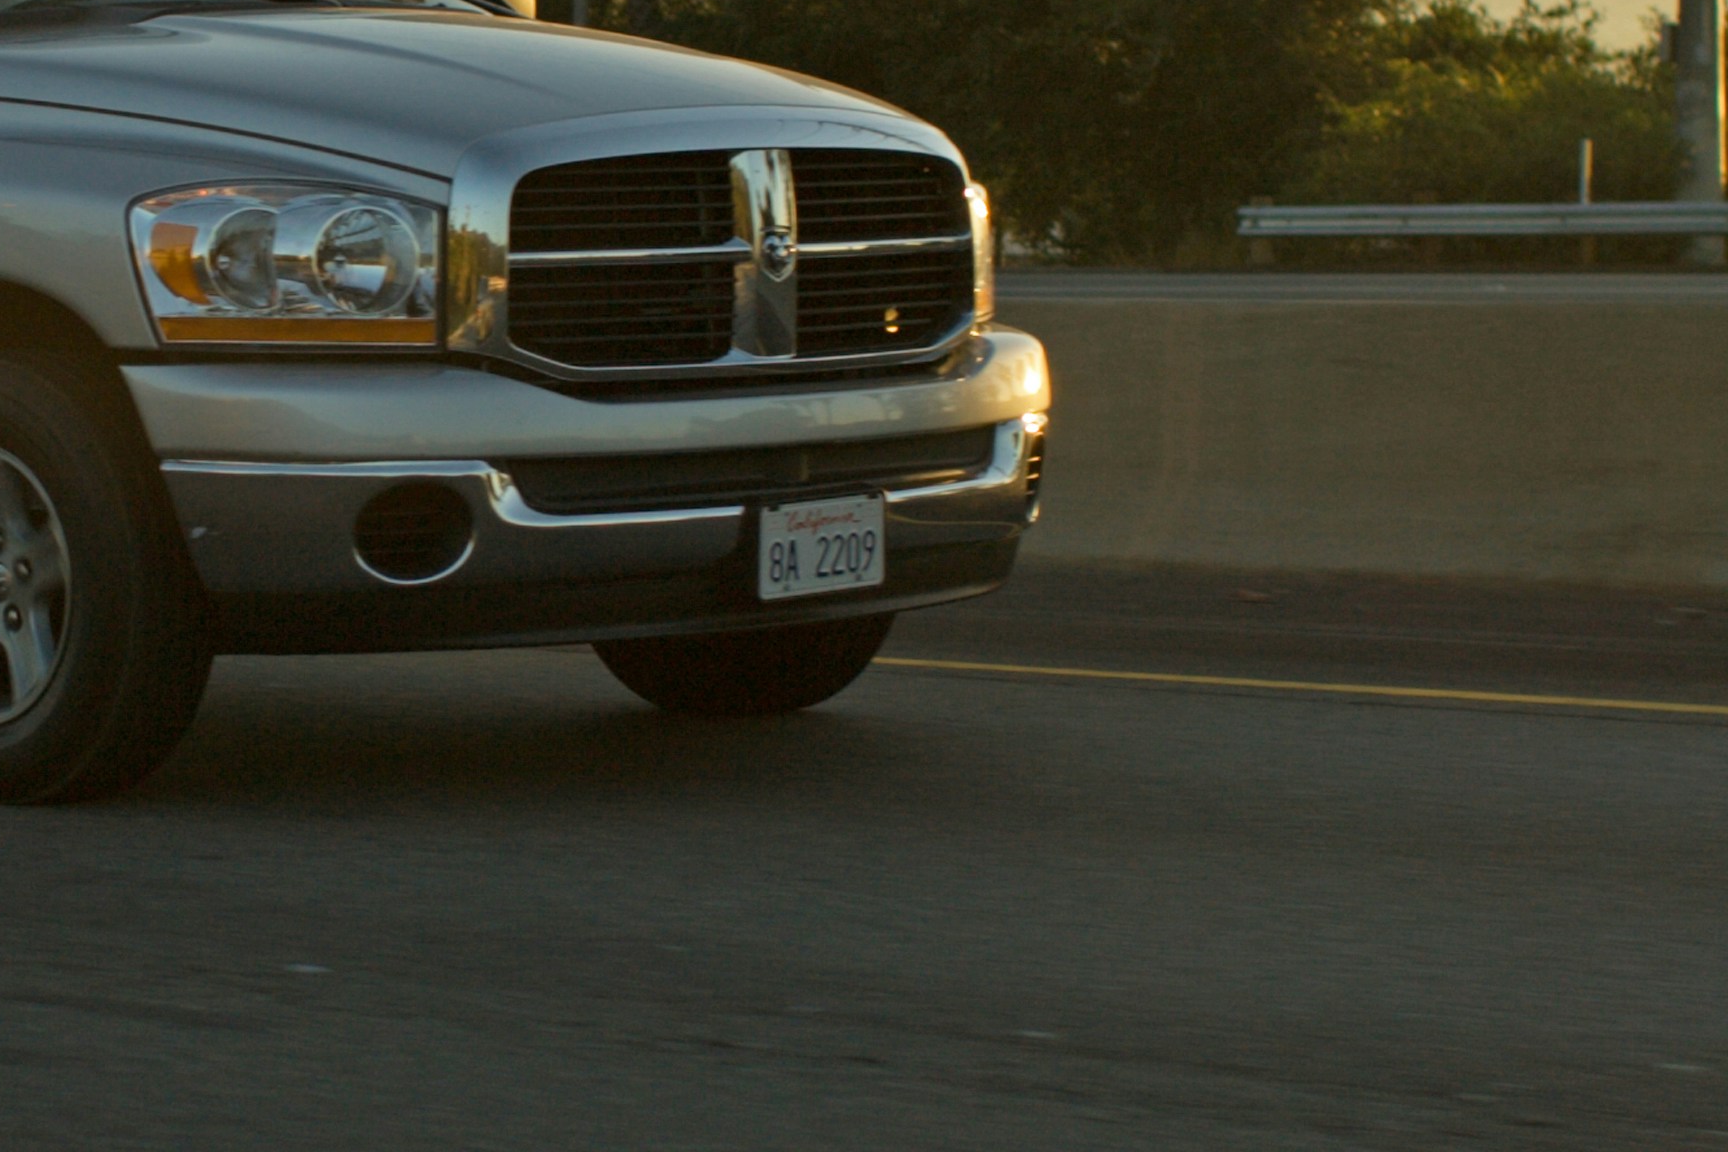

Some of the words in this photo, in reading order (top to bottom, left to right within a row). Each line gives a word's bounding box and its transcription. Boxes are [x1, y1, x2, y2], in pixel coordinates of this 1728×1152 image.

[786, 511, 862, 535] California
[769, 540, 799, 582] 8A
[816, 530, 876, 578] 2209
